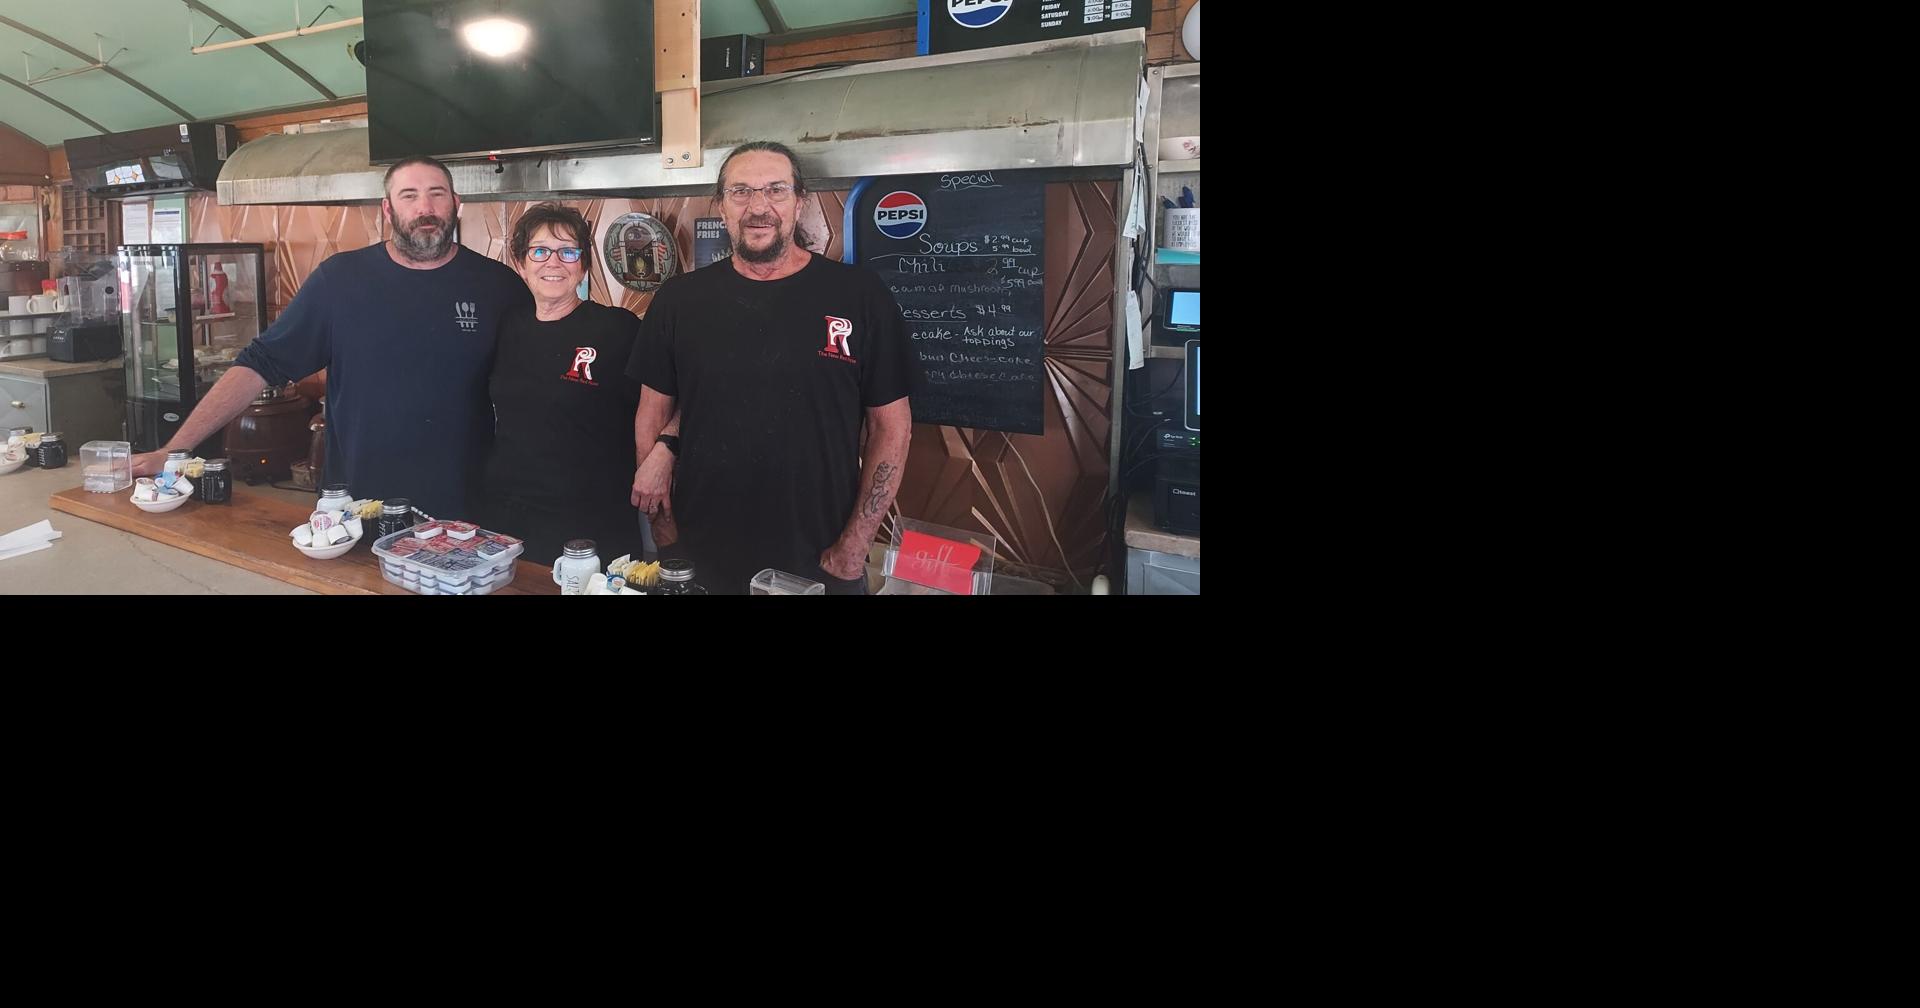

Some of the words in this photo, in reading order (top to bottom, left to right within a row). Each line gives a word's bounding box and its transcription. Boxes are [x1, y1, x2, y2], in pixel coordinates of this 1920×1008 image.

[1041, 3, 1060, 11] FRIDAY
[1041, 10, 1069, 19] SATURDAY
[1041, 20, 1062, 28] SUNDAY
[877, 209, 924, 220] PEPSI
[697, 221, 727, 230] FRENC
[697, 230, 720, 239] FRIES
[919, 233, 978, 256] Soups
[912, 327, 952, 341] ecake
[963, 325, 984, 337] Ask
[988, 325, 1015, 337] about
[1018, 329, 1034, 337] our
[962, 337, 1016, 350] toppings
